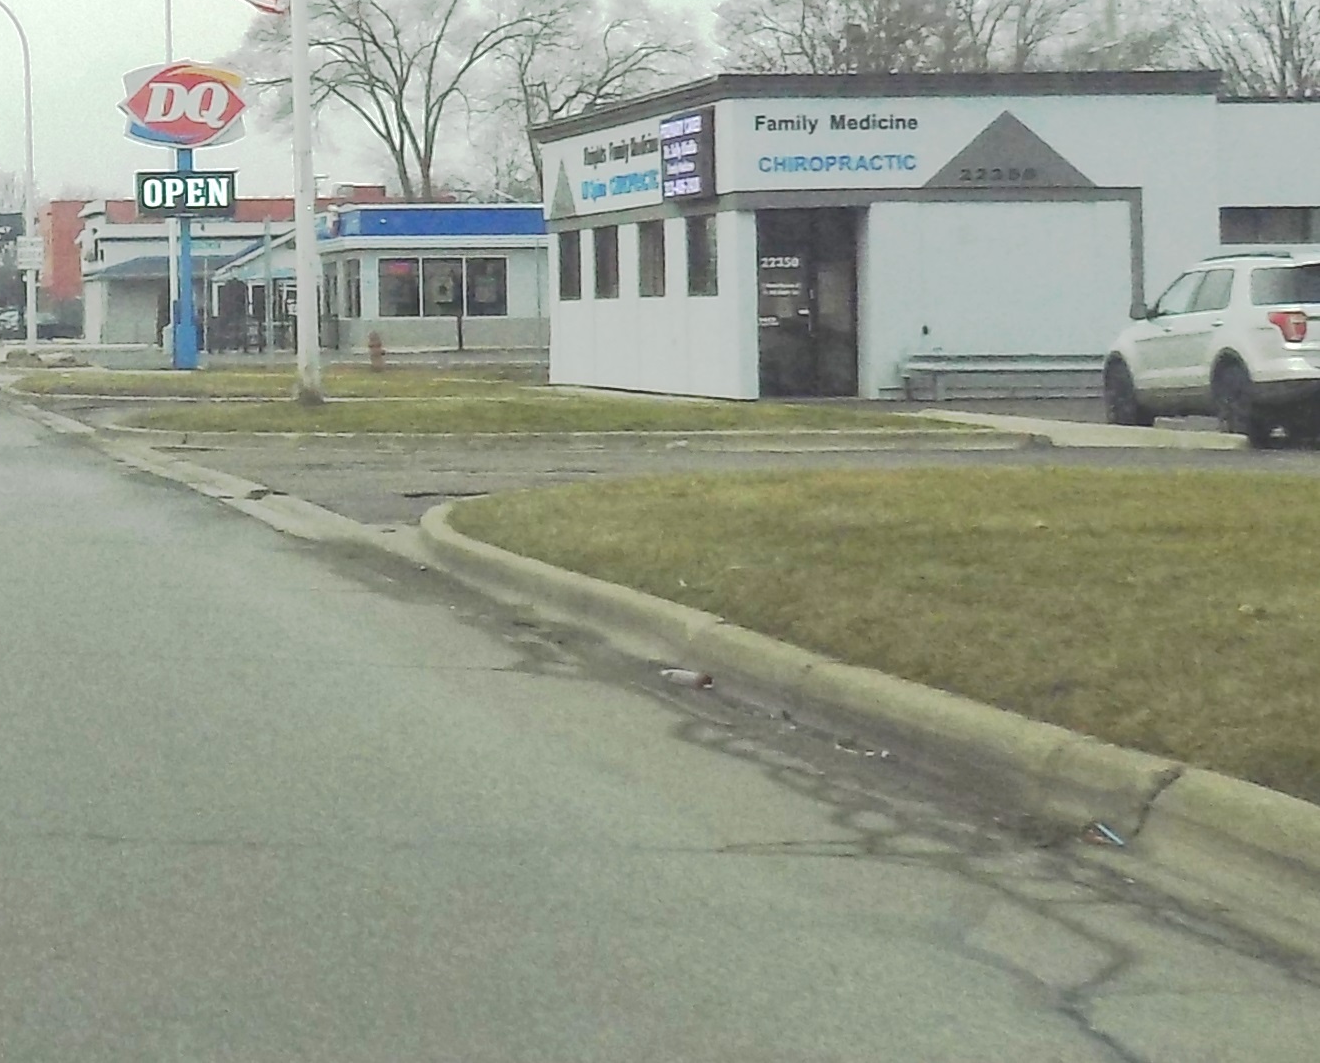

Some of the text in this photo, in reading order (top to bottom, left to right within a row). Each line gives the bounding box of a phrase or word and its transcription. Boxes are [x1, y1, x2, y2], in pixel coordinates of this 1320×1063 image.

[144, 81, 230, 130] DQ
[754, 114, 919, 134] Family Medicine
[758, 154, 917, 173] CHIROPRACTIC
[143, 177, 230, 208] OPEN
